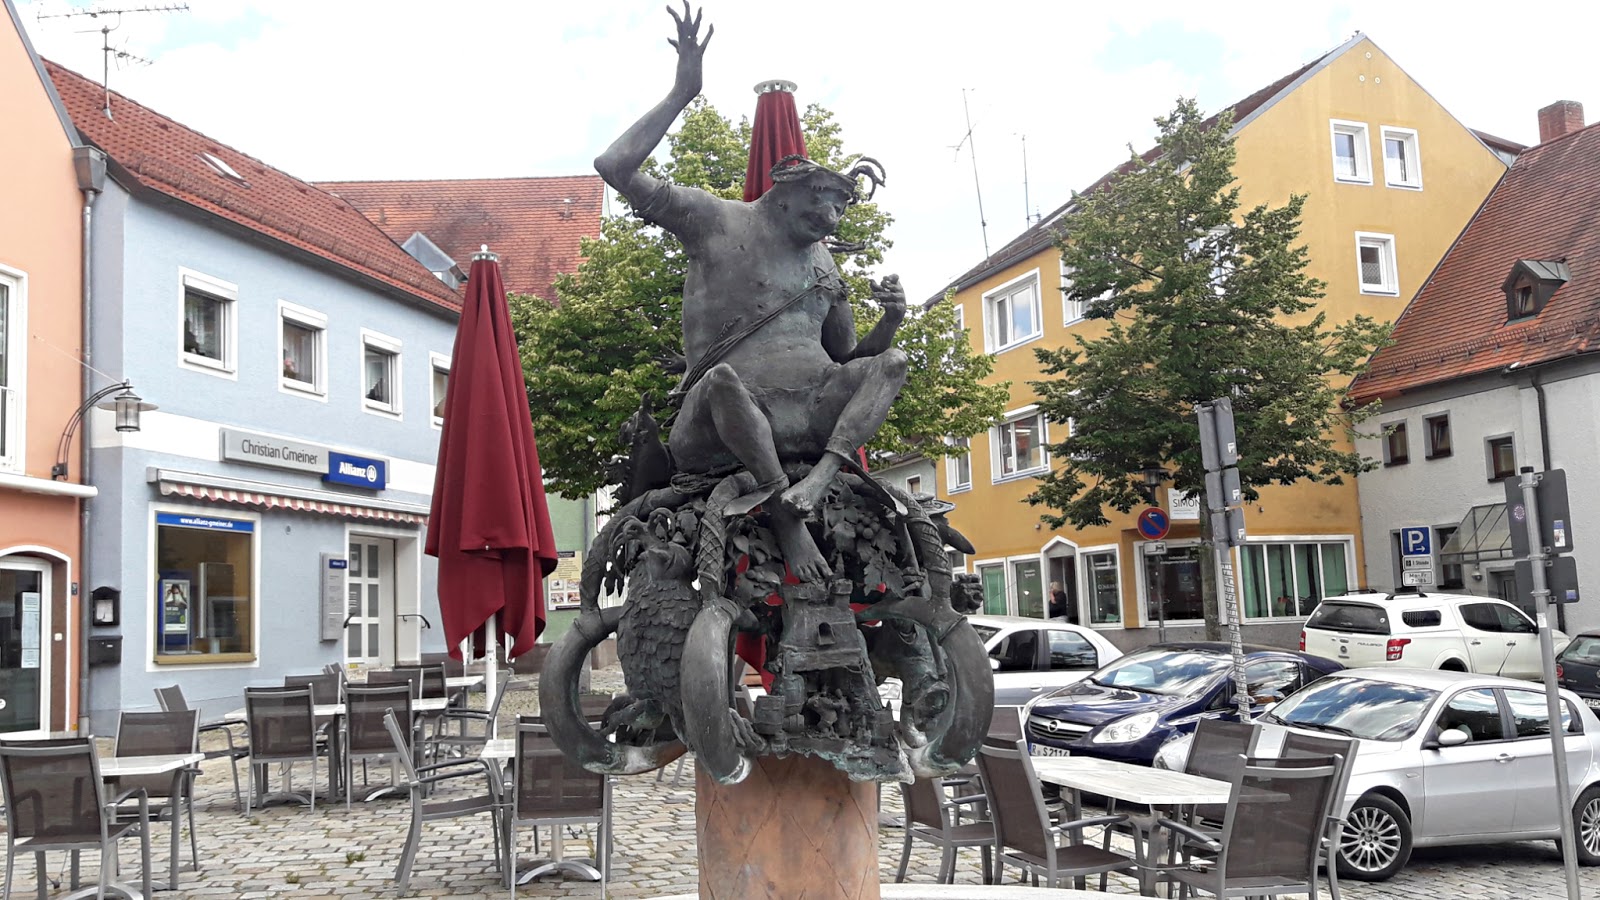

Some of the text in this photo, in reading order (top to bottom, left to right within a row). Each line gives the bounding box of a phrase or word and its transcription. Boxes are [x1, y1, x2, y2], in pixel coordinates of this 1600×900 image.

[241, 439, 318, 465] Christian Gmeiner
[338, 461, 367, 478] Allianz
[180, 517, 234, 528] www.allianz-gmeiner.de
[1407, 530, 1424, 552] P
